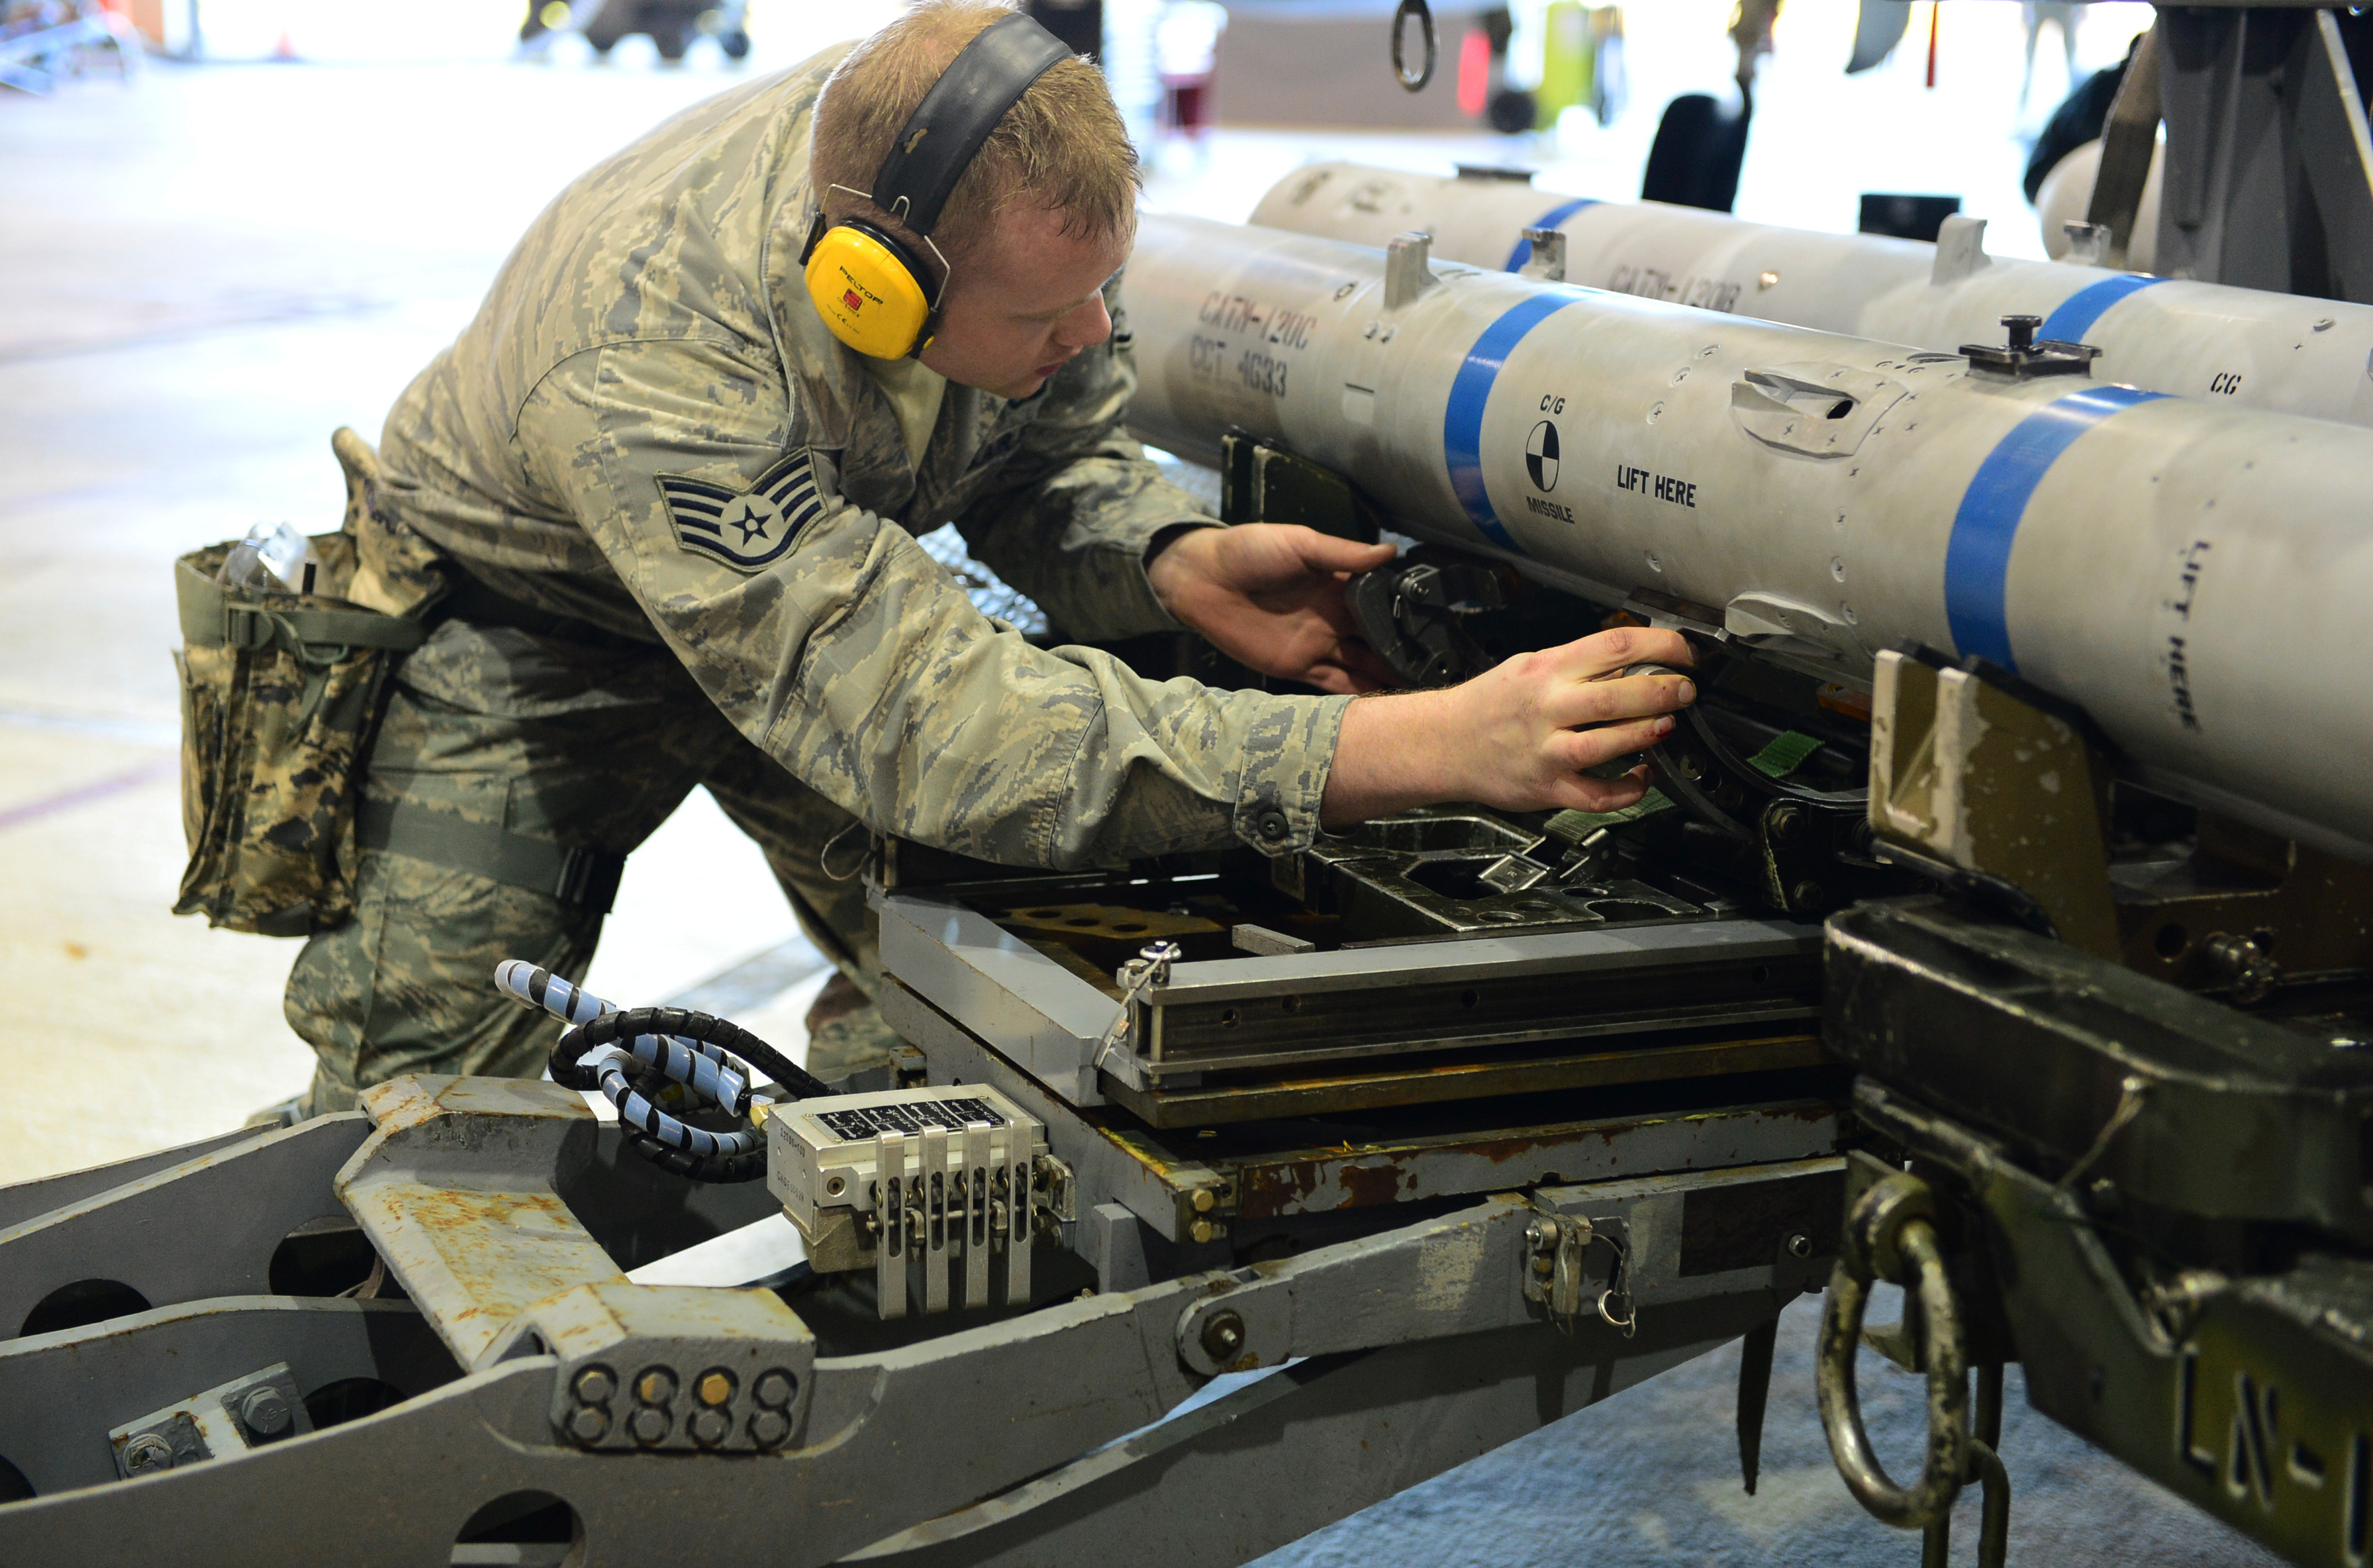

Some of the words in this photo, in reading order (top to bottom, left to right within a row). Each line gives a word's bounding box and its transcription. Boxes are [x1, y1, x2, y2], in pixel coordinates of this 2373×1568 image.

[839, 266, 884, 305] PELTOR
[2210, 372, 2242, 395] CG
[1540, 393, 1566, 415] C/G
[1618, 464, 1651, 495] LIFT
[1655, 475, 1697, 509] HERE
[1526, 495, 1575, 524] MISSILE
[2164, 540, 2210, 622] LIFT
[2163, 636, 2203, 732] HERE
